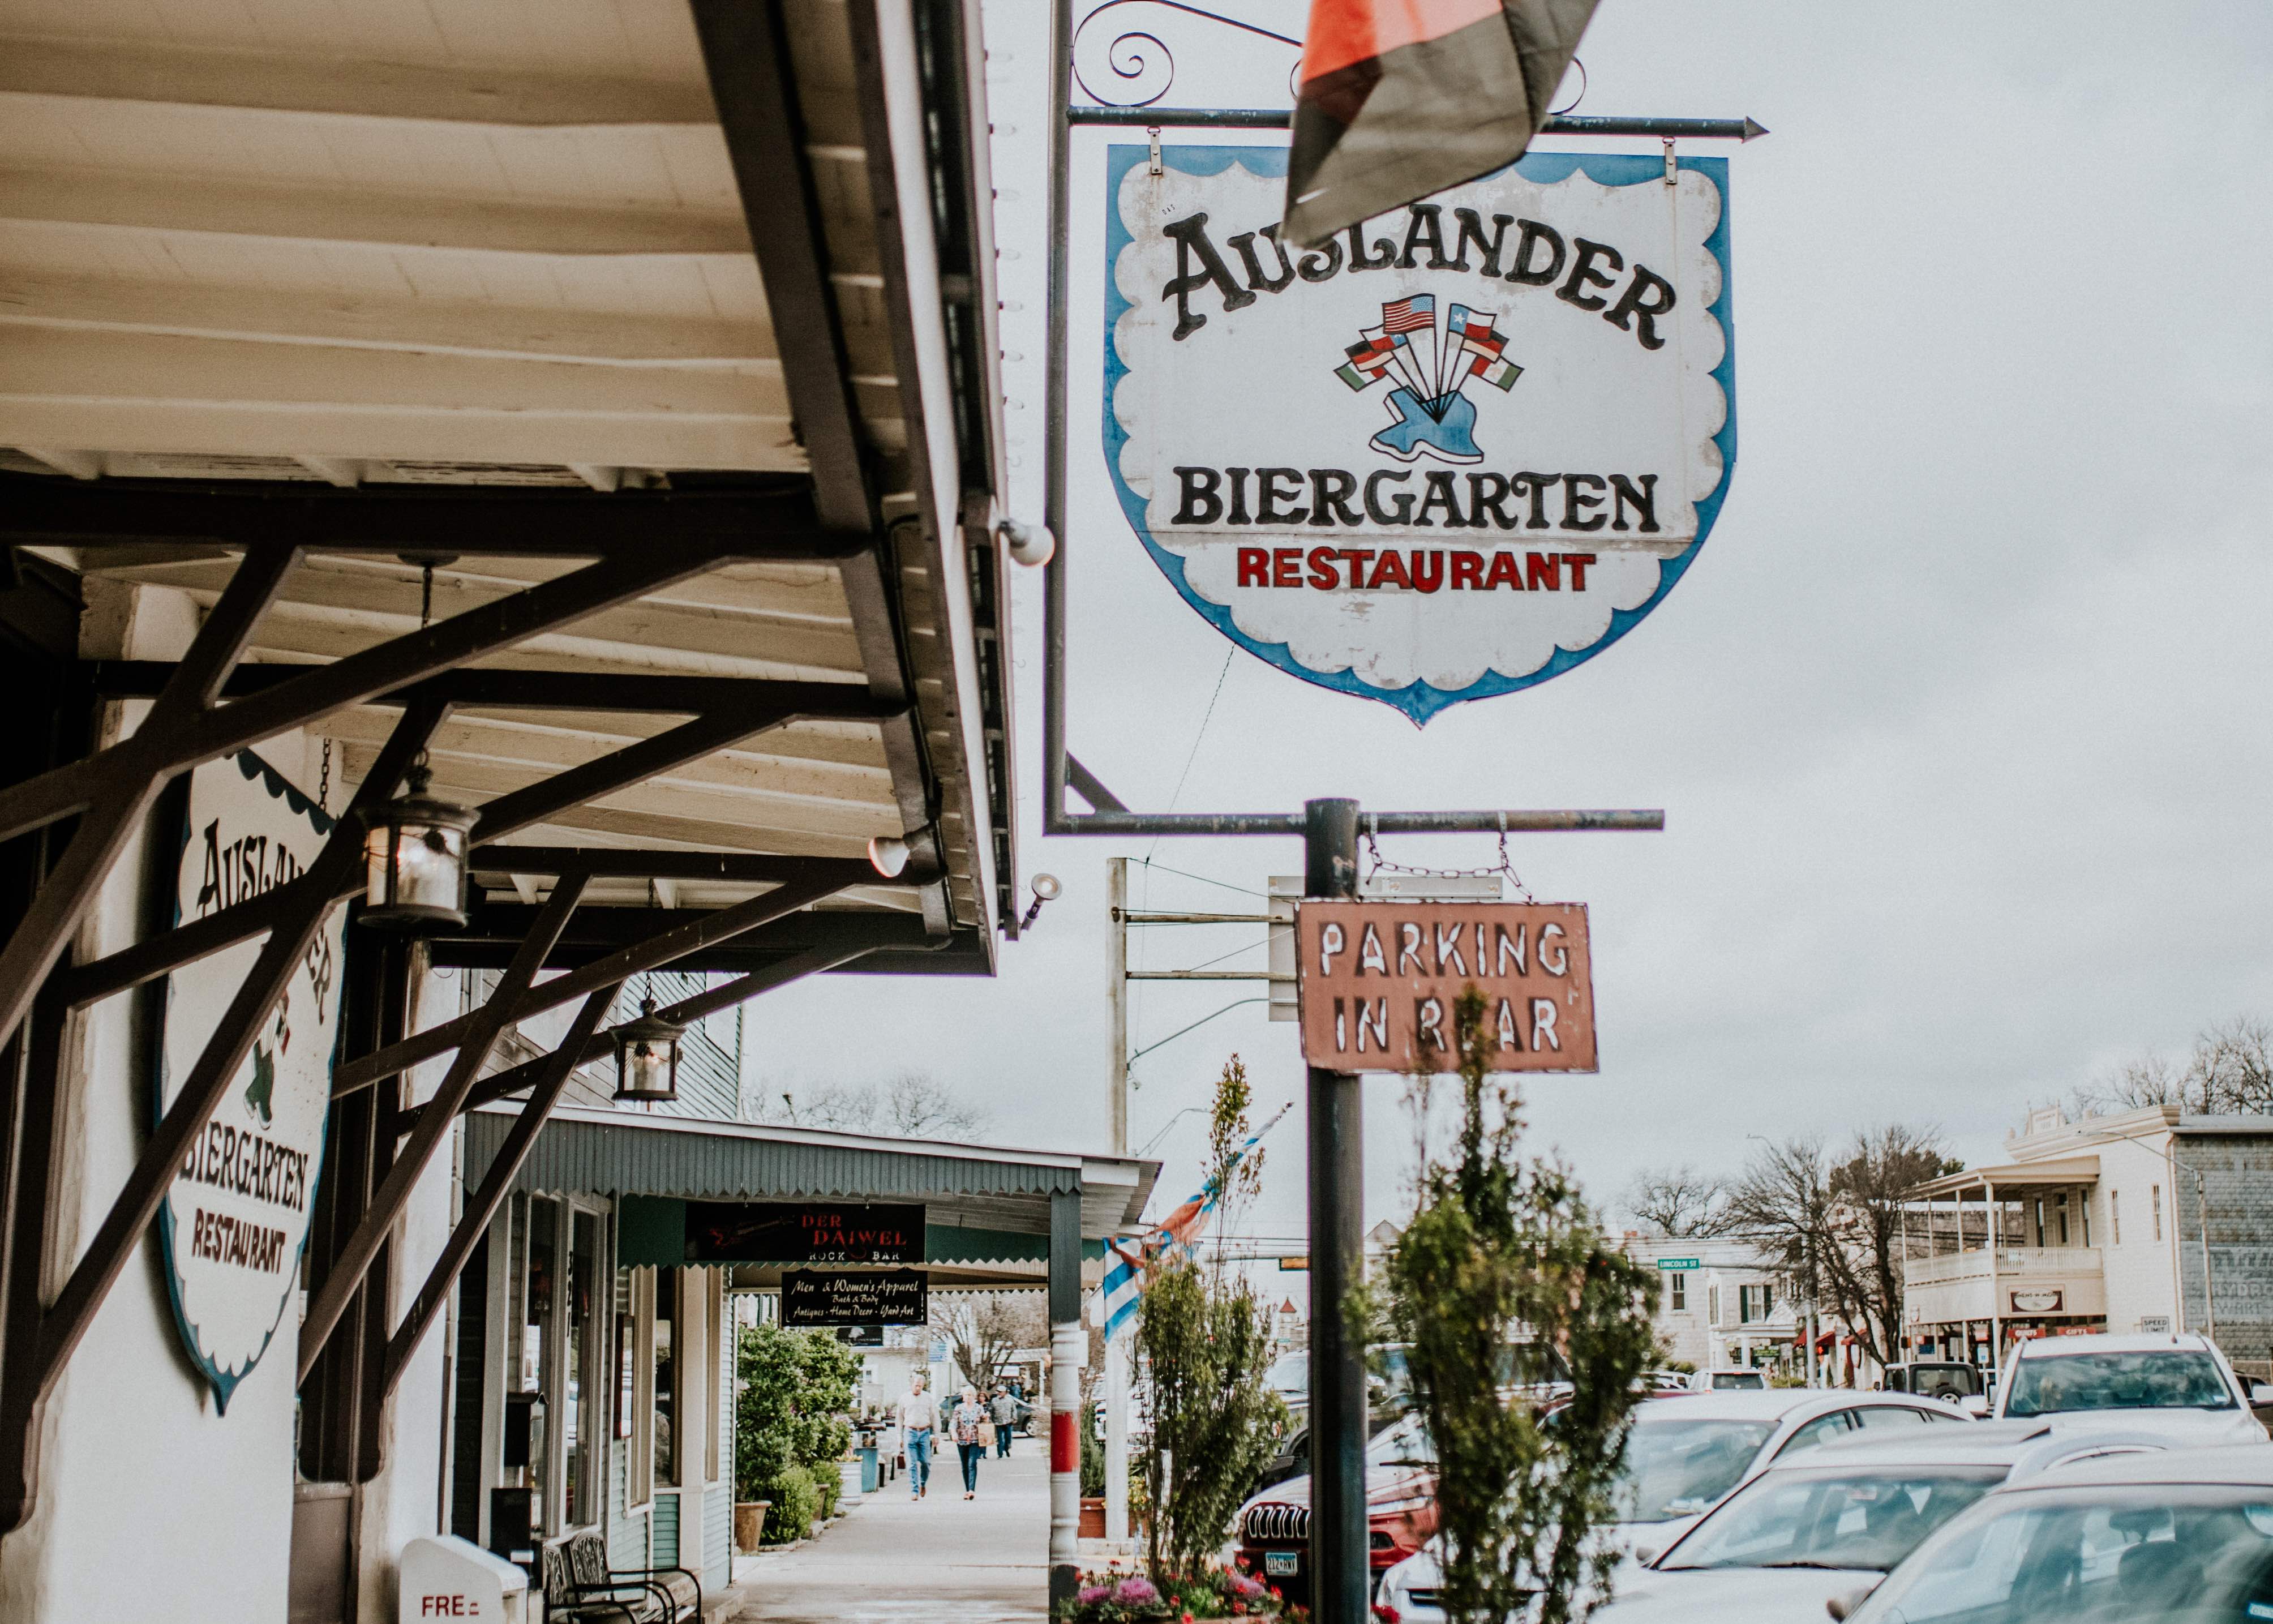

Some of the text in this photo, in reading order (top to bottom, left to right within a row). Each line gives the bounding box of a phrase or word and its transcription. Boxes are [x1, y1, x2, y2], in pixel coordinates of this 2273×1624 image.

[1171, 466, 1660, 532] BIERGARTEN
[1237, 547, 1597, 593] RESTAURANT
[1318, 922, 1569, 978] PARKING
[1334, 997, 1389, 1052] IN
[801, 1214, 842, 1228] DER
[192, 1208, 286, 1274] RESTAURANT
[814, 1230, 906, 1246] DAIWEL
[809, 1251, 900, 1261] ROCK BAR
[791, 1279, 919, 1296] Men & Women's Apparel
[831, 1294, 850, 1303] Bath
[860, 1294, 878, 1305] Body
[793, 1305, 824, 1319] Antiques
[830, 1306, 851, 1316] Home
[852, 1304, 873, 1316] Decor
[899, 1305, 914, 1317] Art
